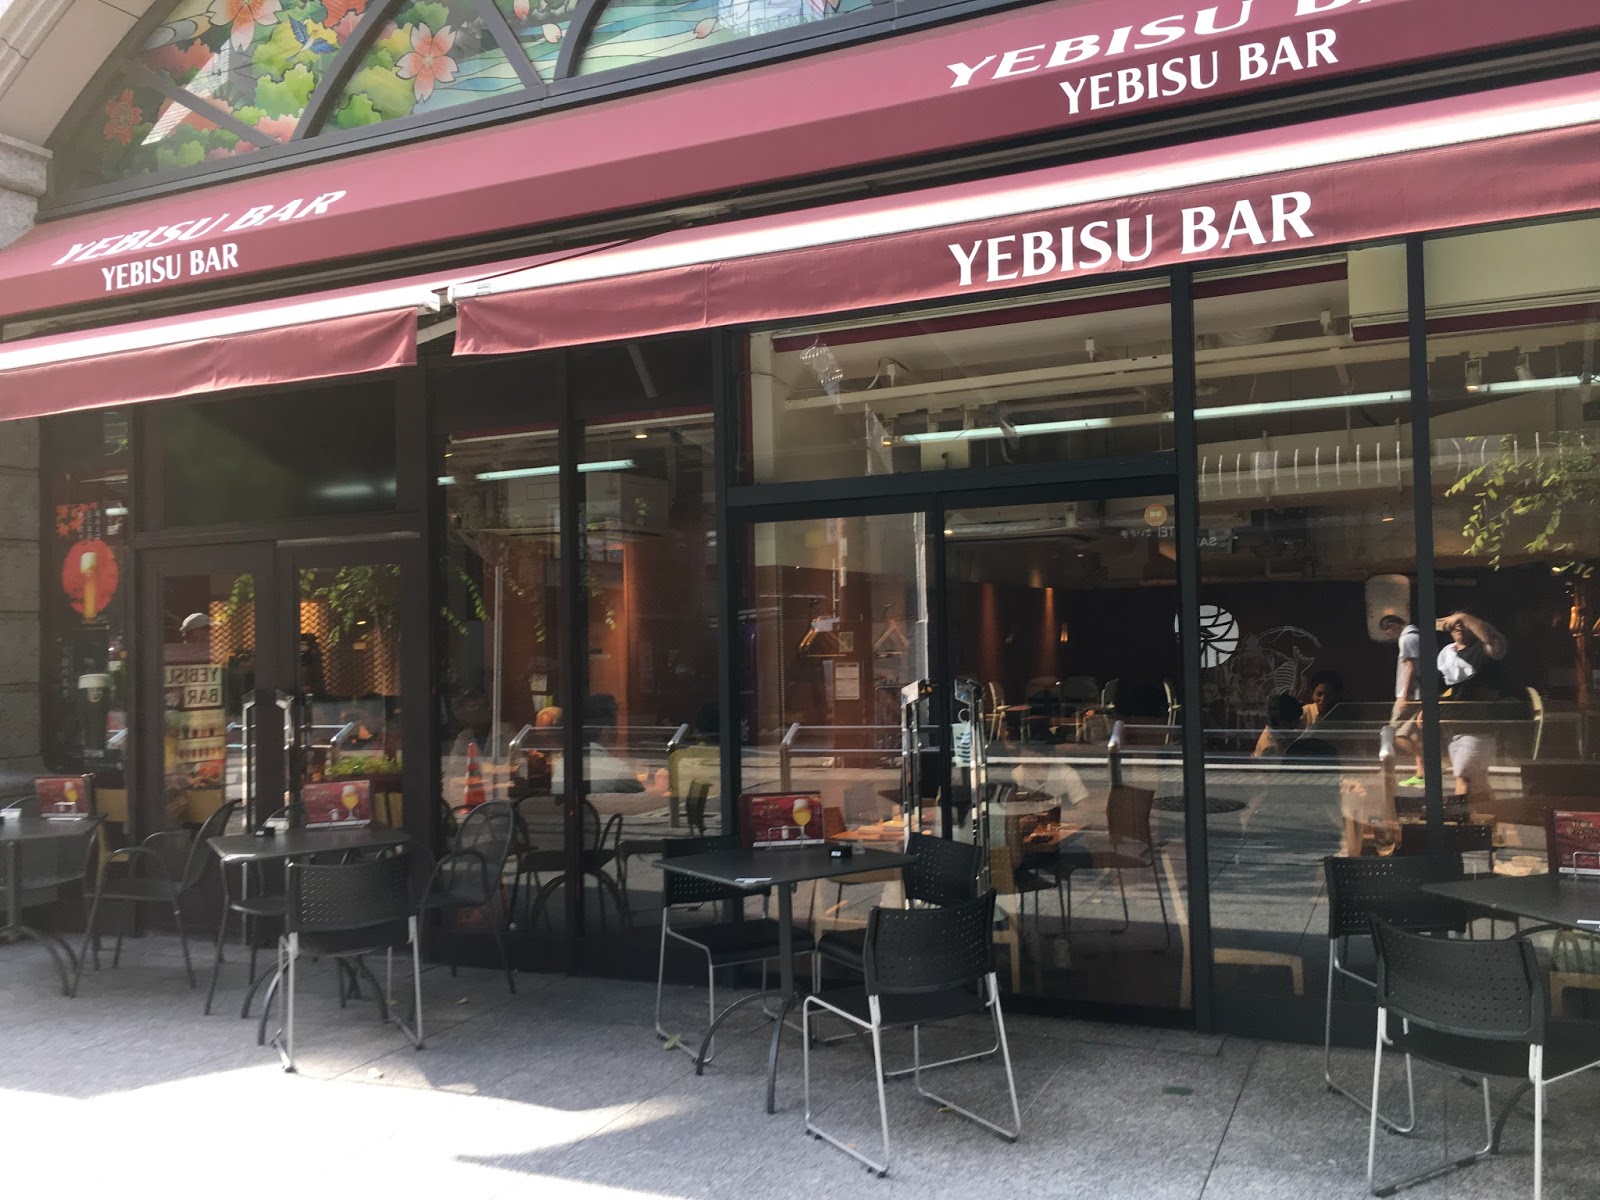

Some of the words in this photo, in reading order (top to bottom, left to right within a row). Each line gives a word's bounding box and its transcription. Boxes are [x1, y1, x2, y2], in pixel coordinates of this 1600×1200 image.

[946, 0, 1254, 90] YEBISU
[1060, 50, 1219, 115] YEBISU
[1238, 28, 1340, 82] BAR
[51, 213, 230, 266] YEBISU
[222, 190, 347, 233] BAR
[101, 253, 181, 291] YEBISU
[189, 242, 239, 276] BAR
[948, 213, 1153, 287] YEBISU
[1180, 190, 1315, 256] BAR
